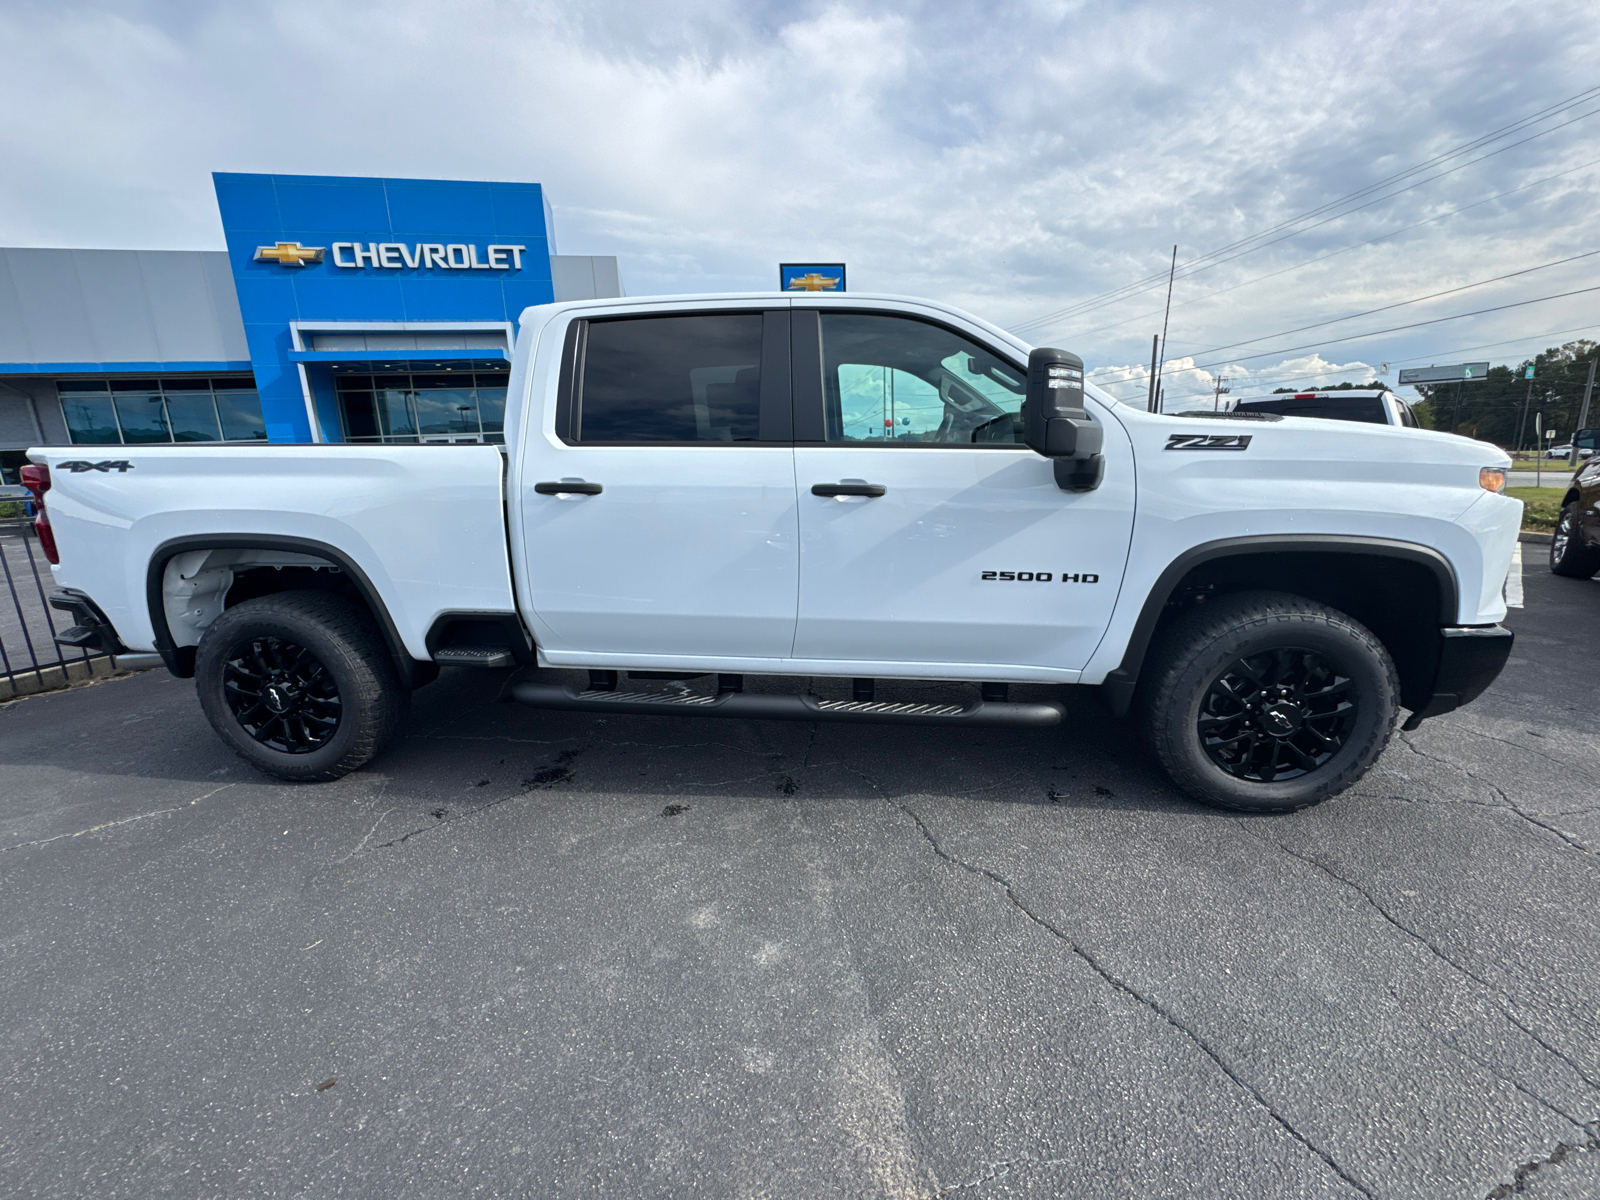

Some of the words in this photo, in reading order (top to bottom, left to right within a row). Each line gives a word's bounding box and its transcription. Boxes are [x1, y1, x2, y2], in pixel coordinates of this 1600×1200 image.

[331, 241, 526, 270] CHEVROLET
[1164, 433, 1253, 451] Z71
[981, 570, 1053, 582] 2500
[1062, 573, 1099, 583] HD
